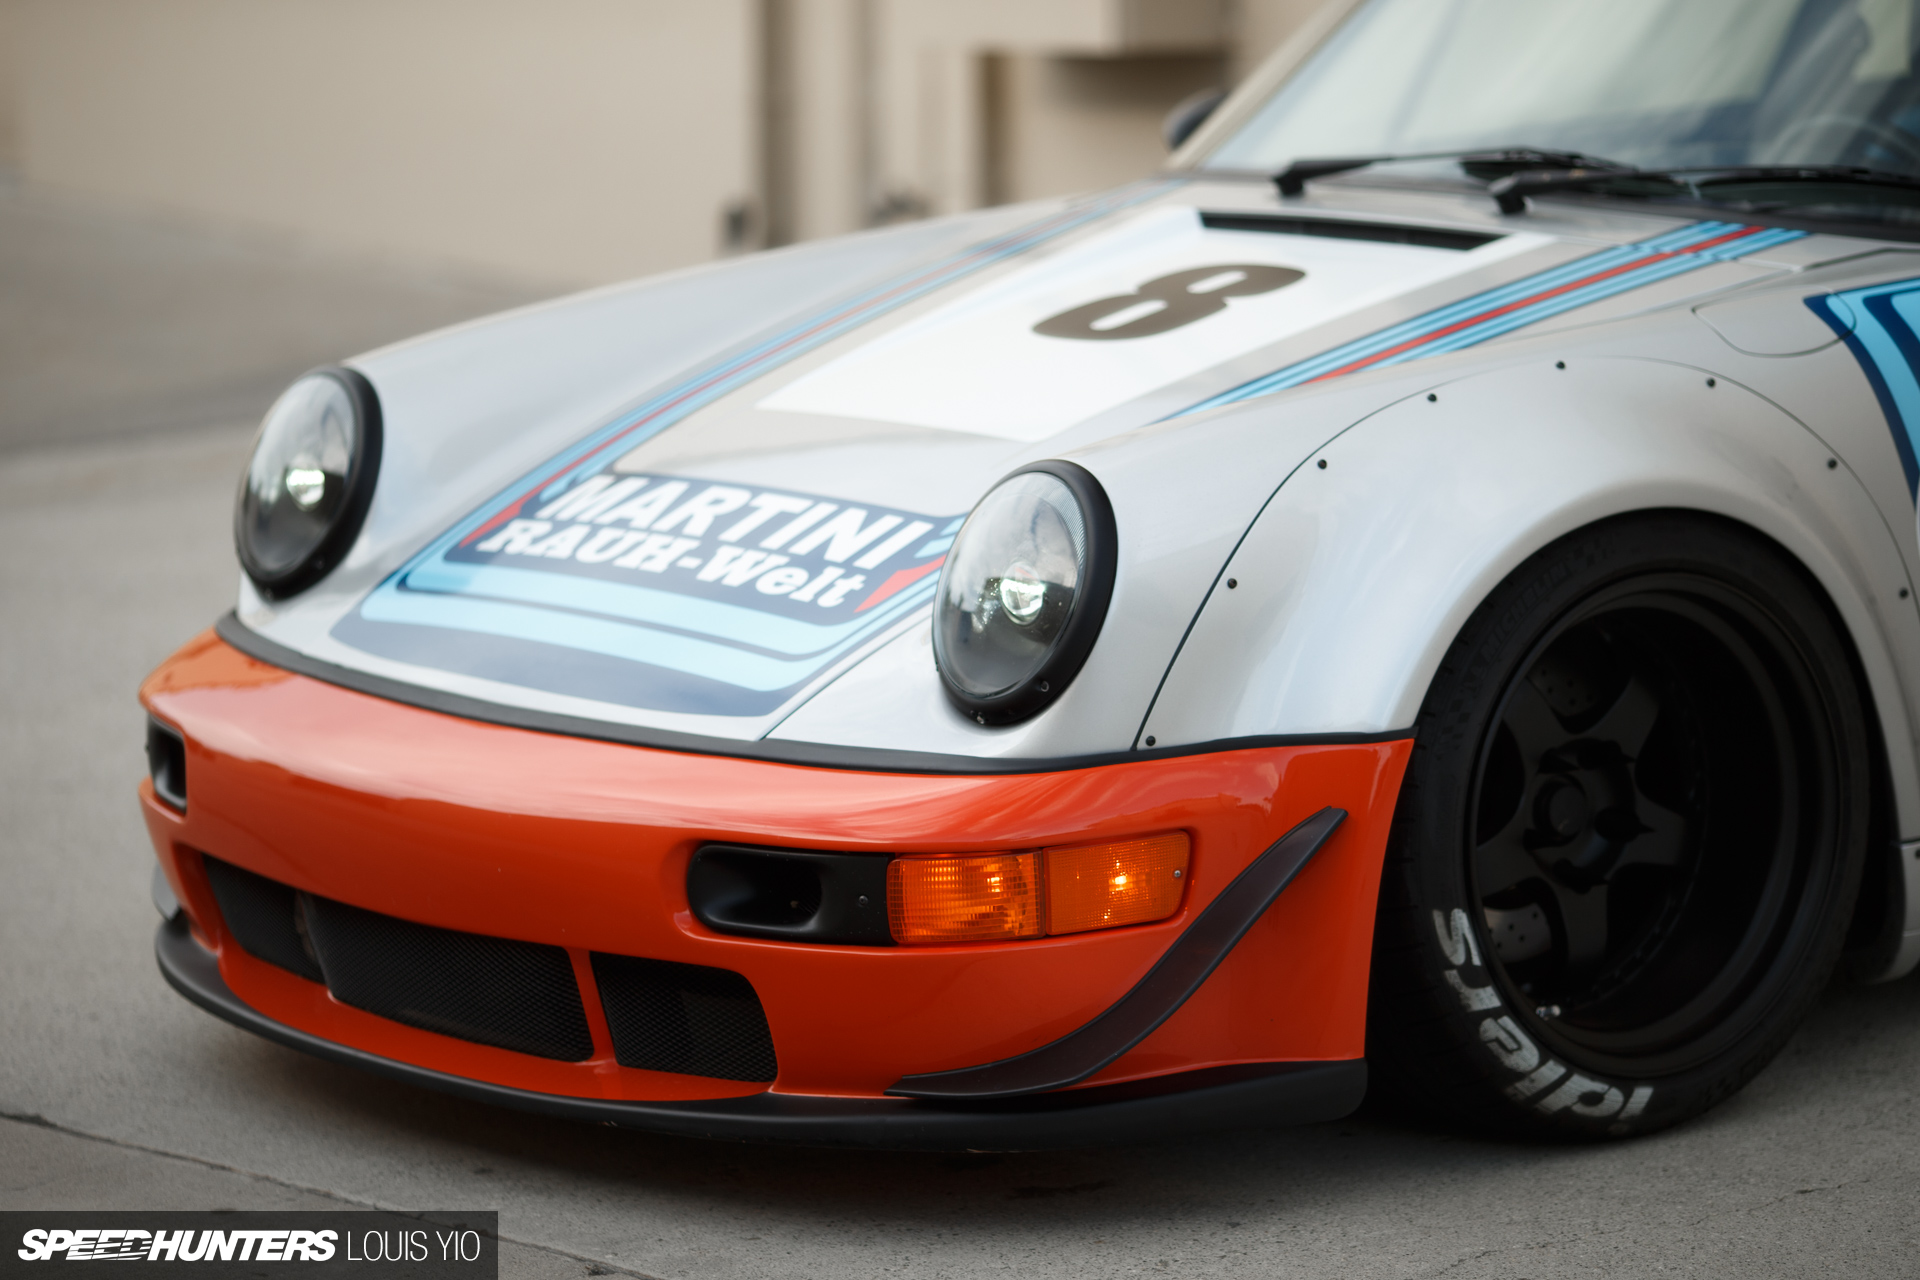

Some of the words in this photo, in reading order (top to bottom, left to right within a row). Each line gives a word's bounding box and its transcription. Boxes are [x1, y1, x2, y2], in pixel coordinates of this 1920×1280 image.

[1032, 264, 1307, 340] 8
[476, 519, 866, 607] RAUH-Welt
[536, 473, 934, 570] MARTINI
[1479, 560, 1571, 663] MICHELIN
